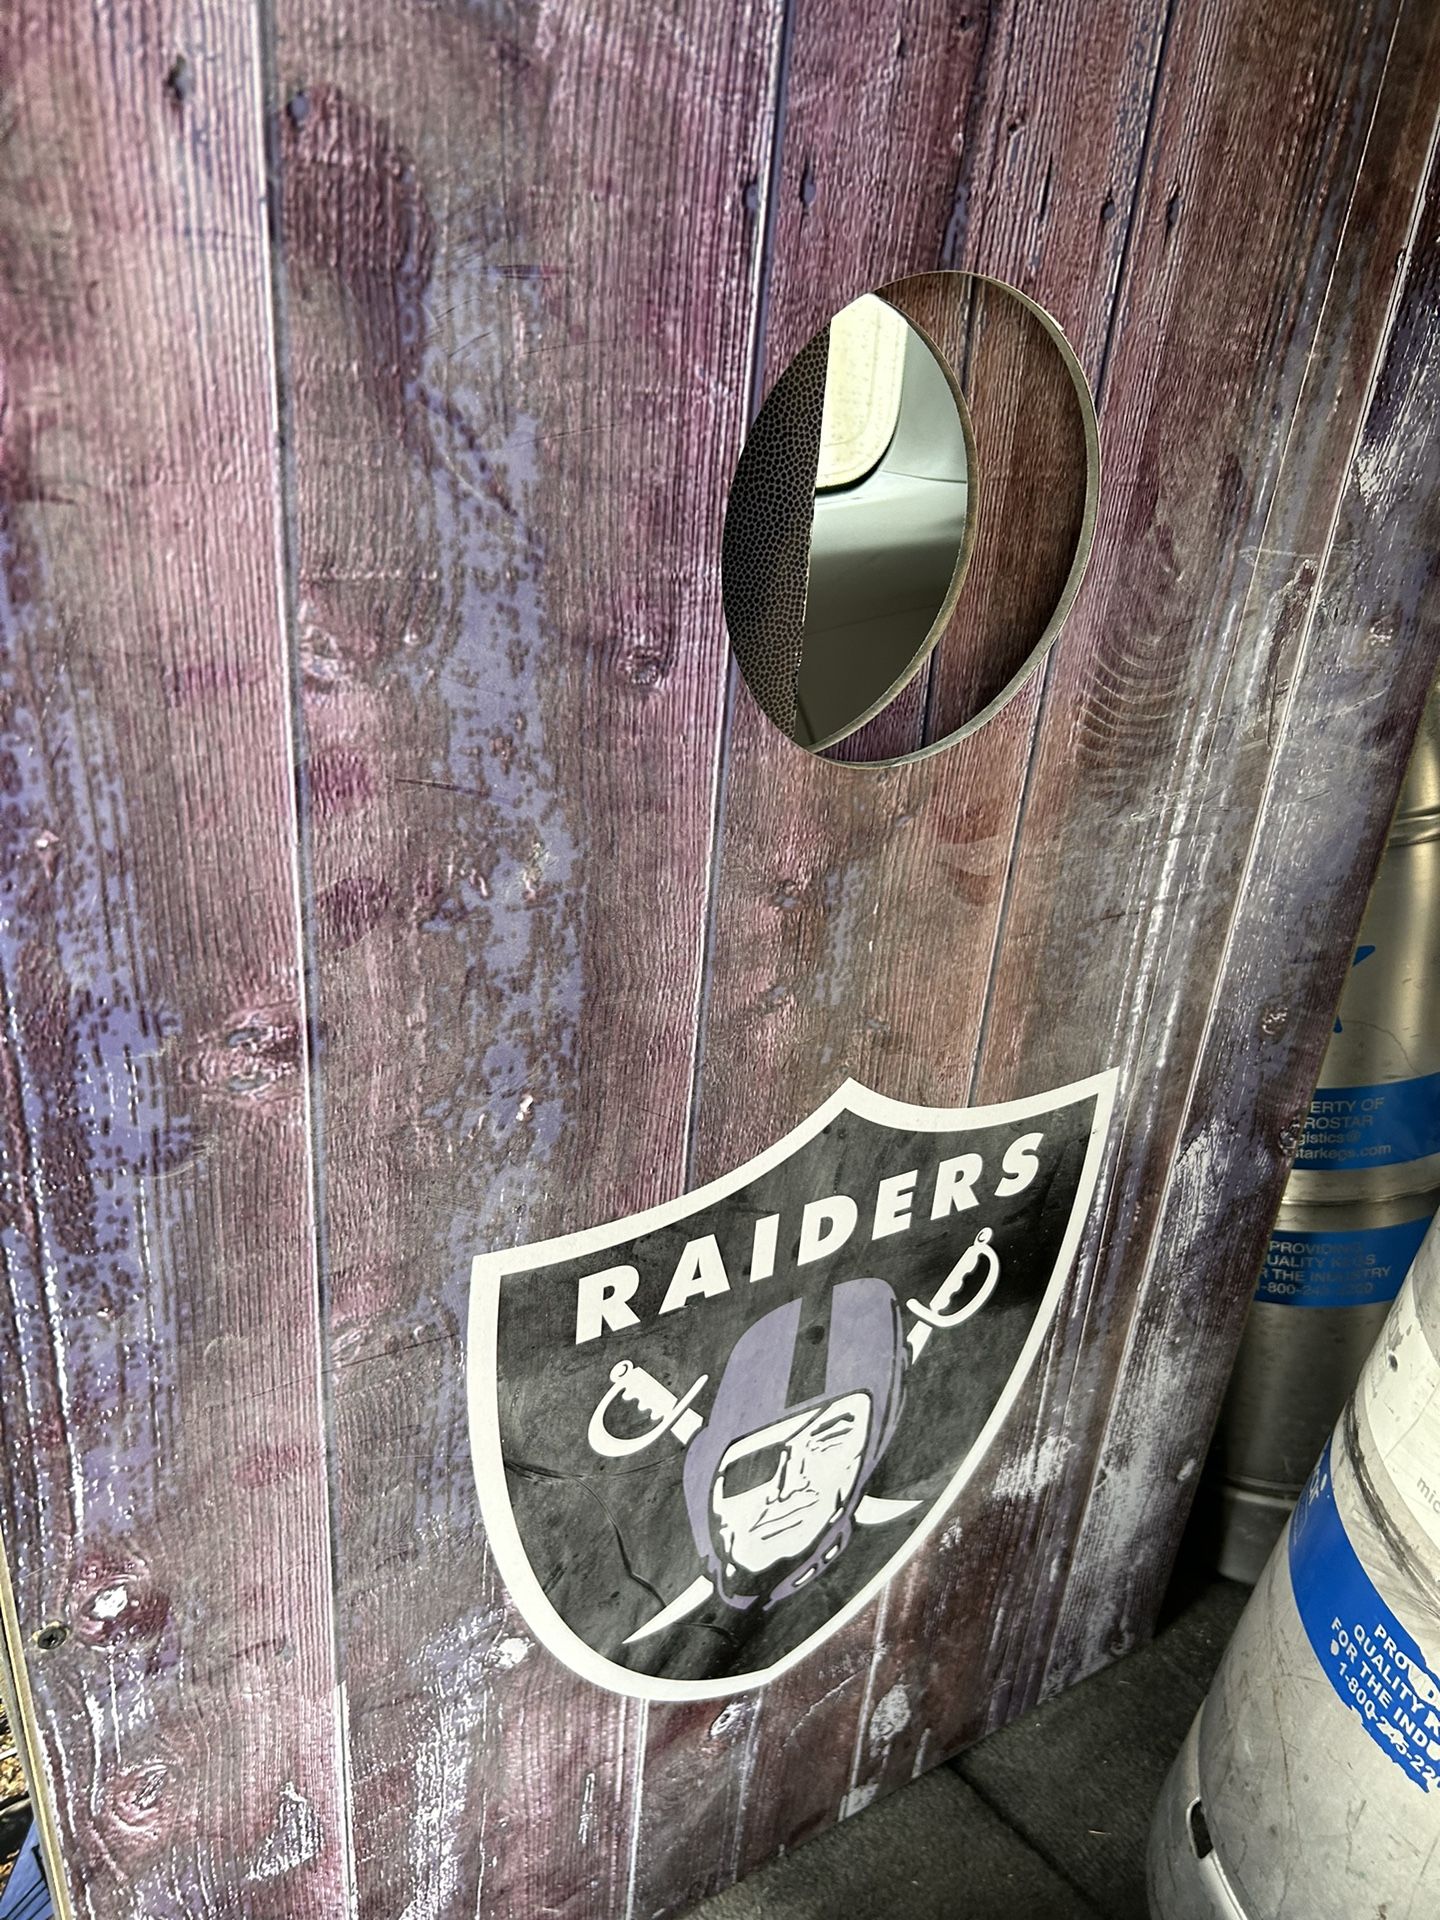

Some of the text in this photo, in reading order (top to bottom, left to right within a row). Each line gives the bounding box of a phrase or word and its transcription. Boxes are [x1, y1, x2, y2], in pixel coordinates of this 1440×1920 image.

[1309, 1096, 1385, 1113] ERTY OF
[1303, 1115, 1374, 1129] ROSTAR
[576, 1132, 1044, 1345] RAIDERS
[1266, 1254, 1326, 1268] UALITY
[1271, 1267, 1307, 1282] THE
[1310, 1266, 1392, 1282] INDSTRY
[1331, 1616, 1359, 1664] FOR
[1359, 1660, 1393, 1710] THE
[1353, 1624, 1425, 1714] QUALITY
